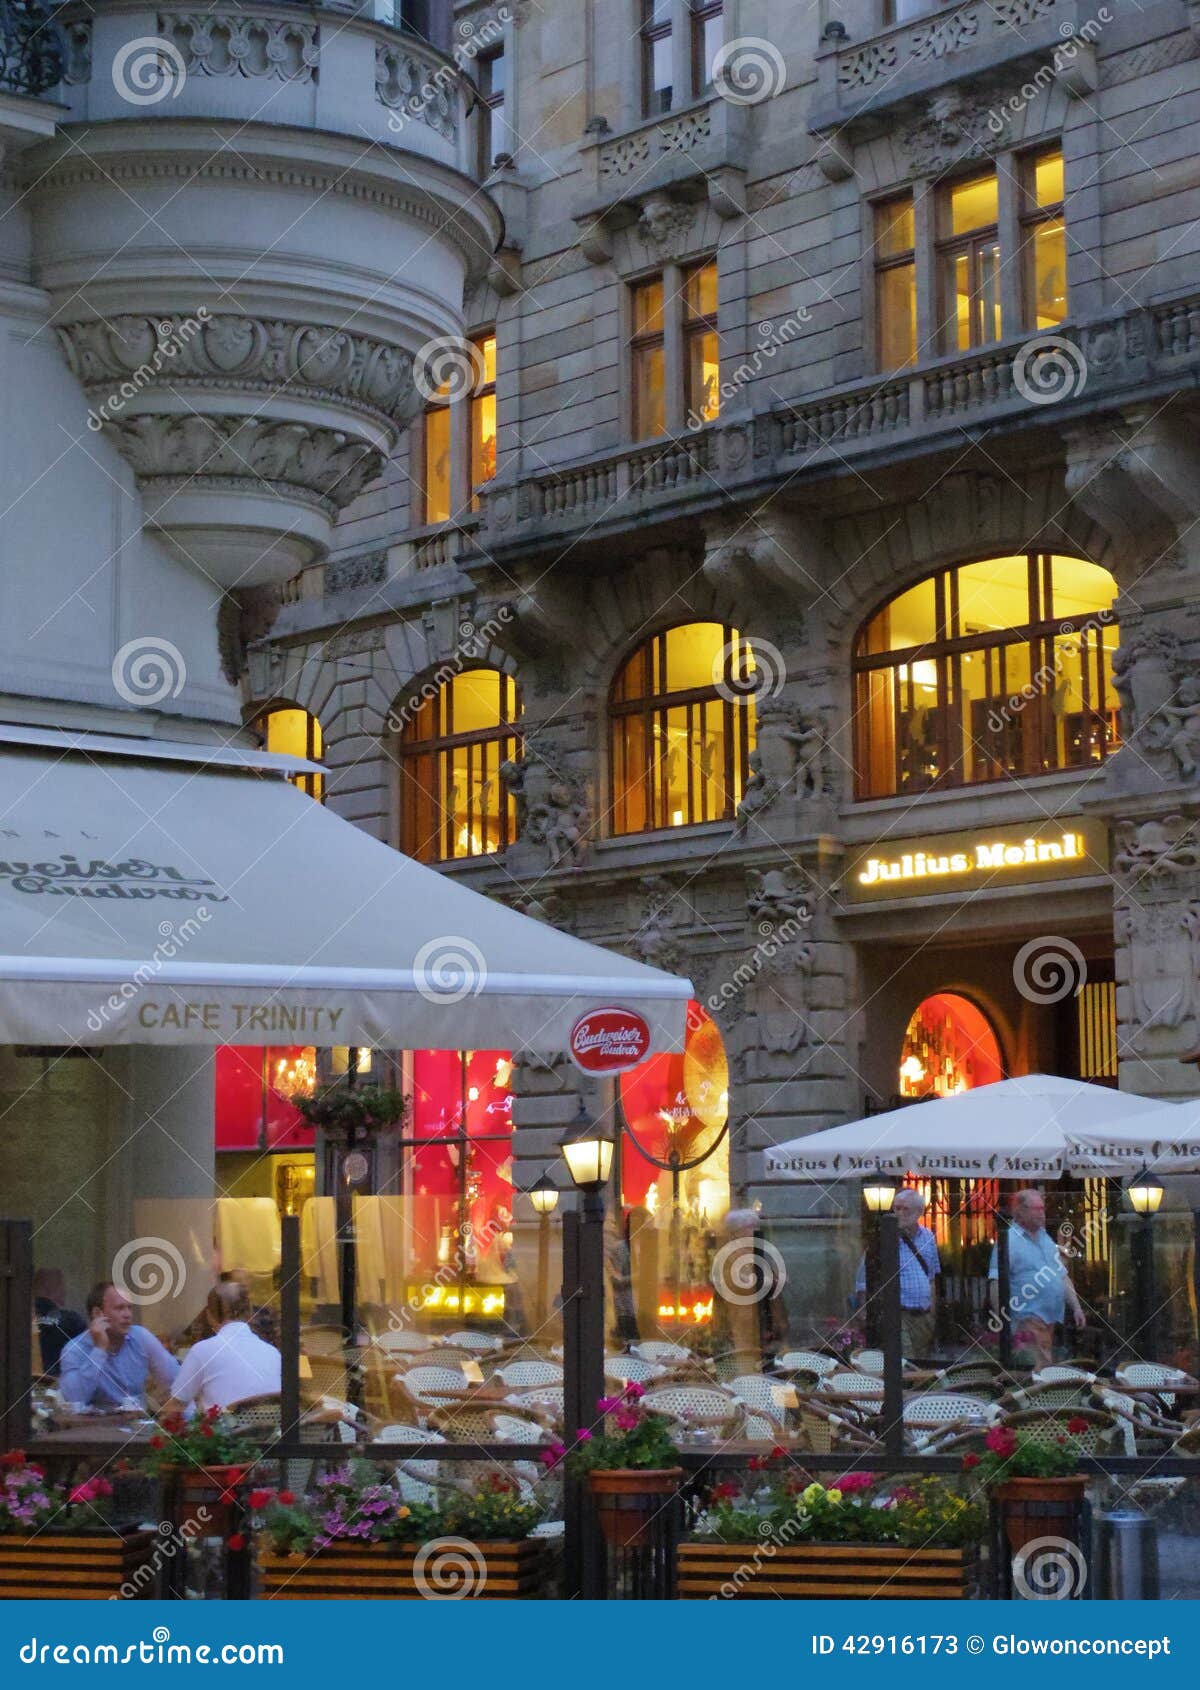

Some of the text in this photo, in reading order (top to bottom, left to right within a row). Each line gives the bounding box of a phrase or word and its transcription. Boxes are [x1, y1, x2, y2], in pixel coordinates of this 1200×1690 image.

[859, 832, 1080, 885] Julius Meinl
[138, 1002, 344, 1032] CAFE TRINITY
[573, 1024, 643, 1053] Budweiser
[599, 1041, 640, 1056] Budvar
[766, 1154, 904, 1172] Julius Meinl
[917, 1154, 982, 1169] Julius
[1003, 1156, 1063, 1172] Meinl
